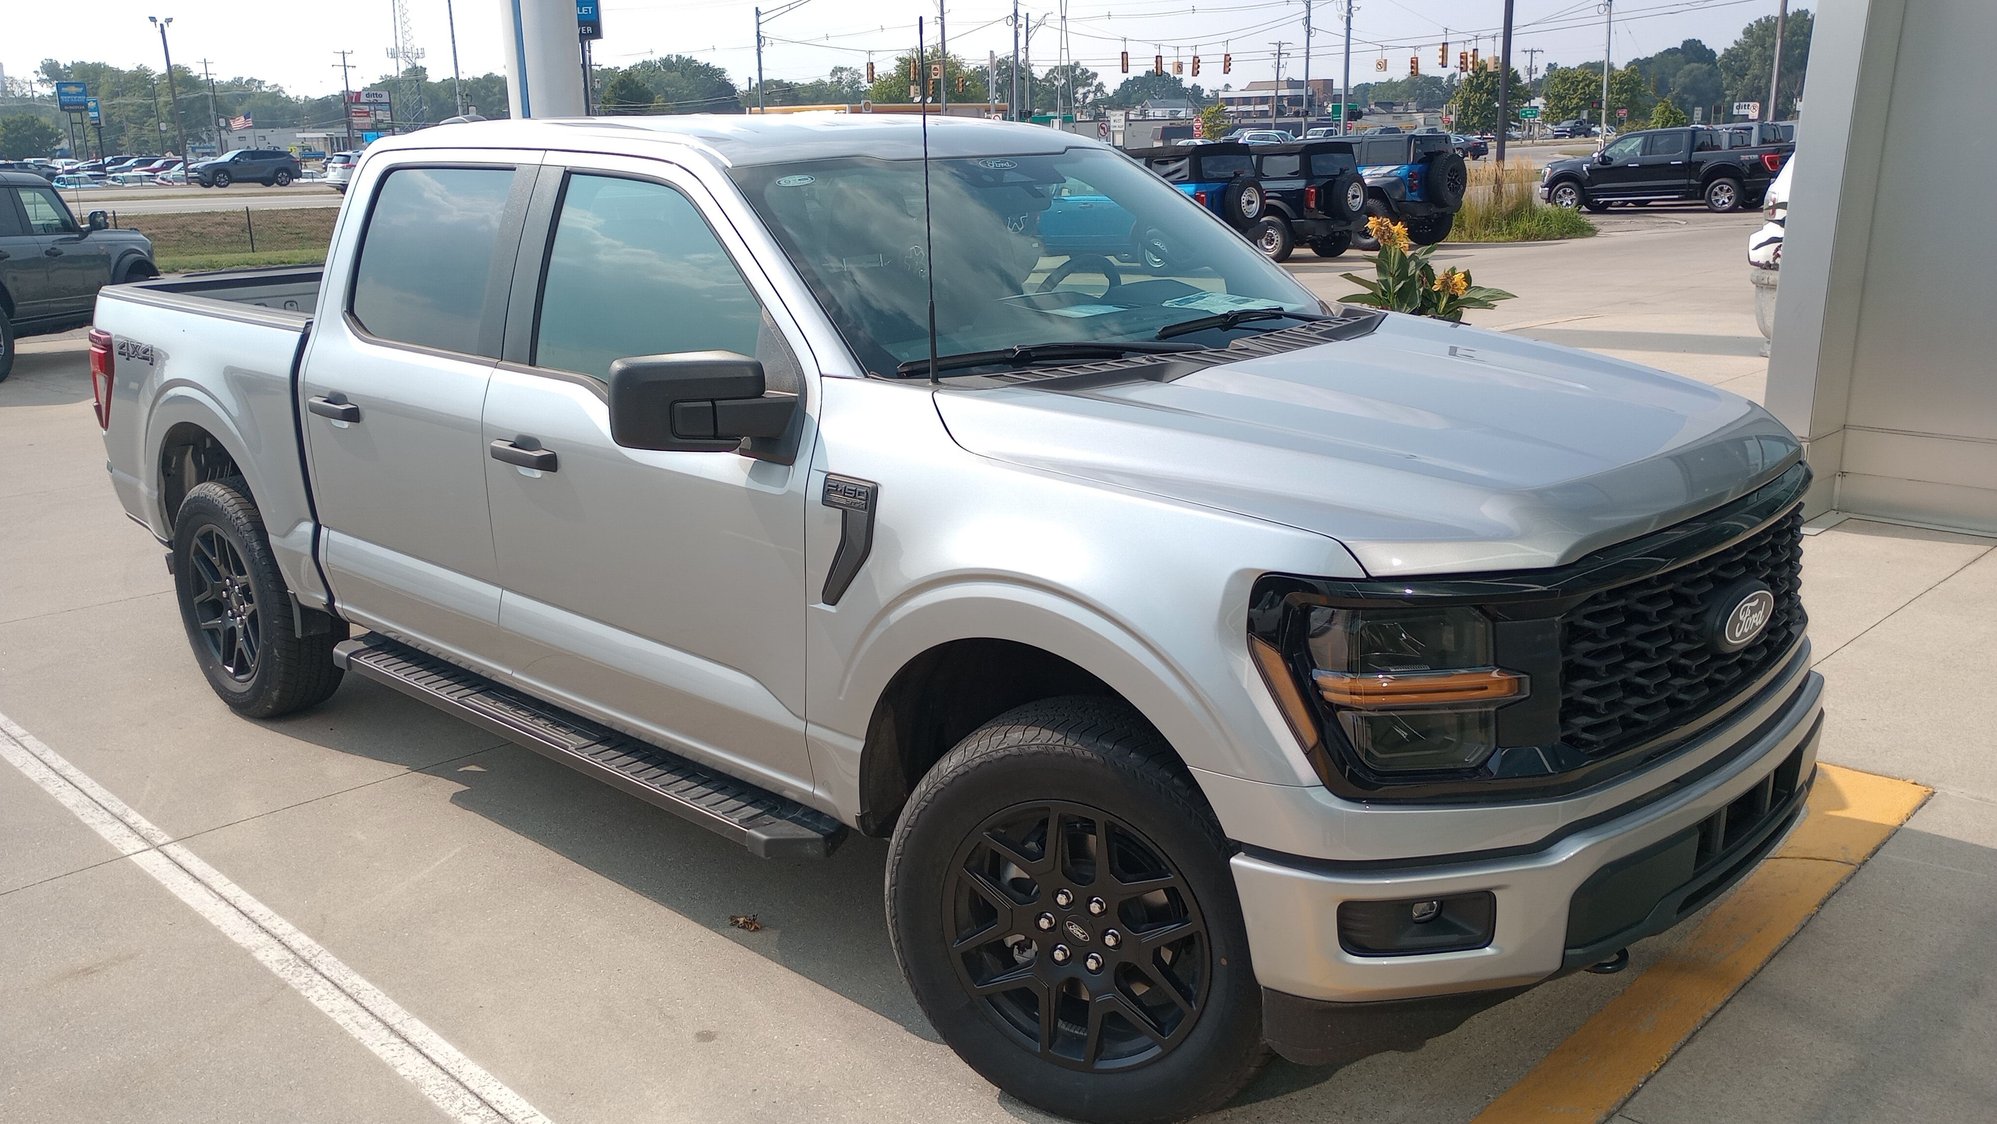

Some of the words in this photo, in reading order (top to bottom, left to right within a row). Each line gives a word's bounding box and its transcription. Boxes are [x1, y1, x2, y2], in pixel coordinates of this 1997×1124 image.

[1735, 102, 1750, 110] ditt
[1735, 598, 1766, 638] Ford
[1069, 922, 1086, 941] Ford
